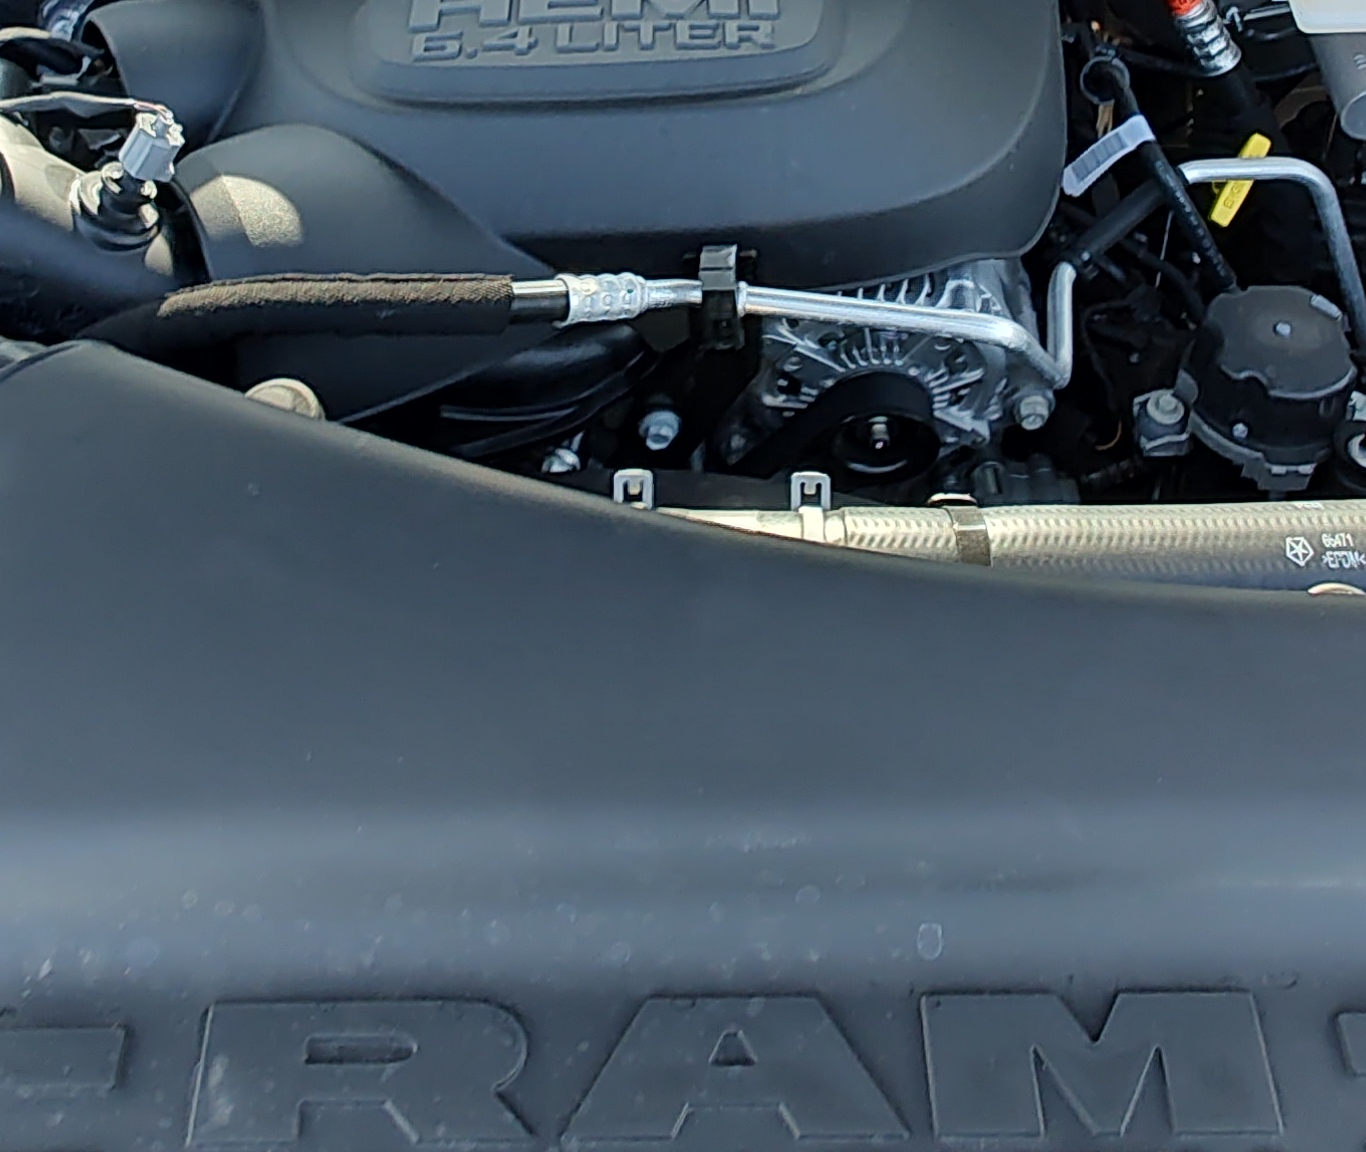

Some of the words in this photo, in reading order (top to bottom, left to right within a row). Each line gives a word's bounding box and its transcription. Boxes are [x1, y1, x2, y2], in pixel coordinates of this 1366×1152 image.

[411, 28, 541, 62] 6.4
[554, 19, 775, 54] LITER
[183, 988, 1287, 1146] RAM
